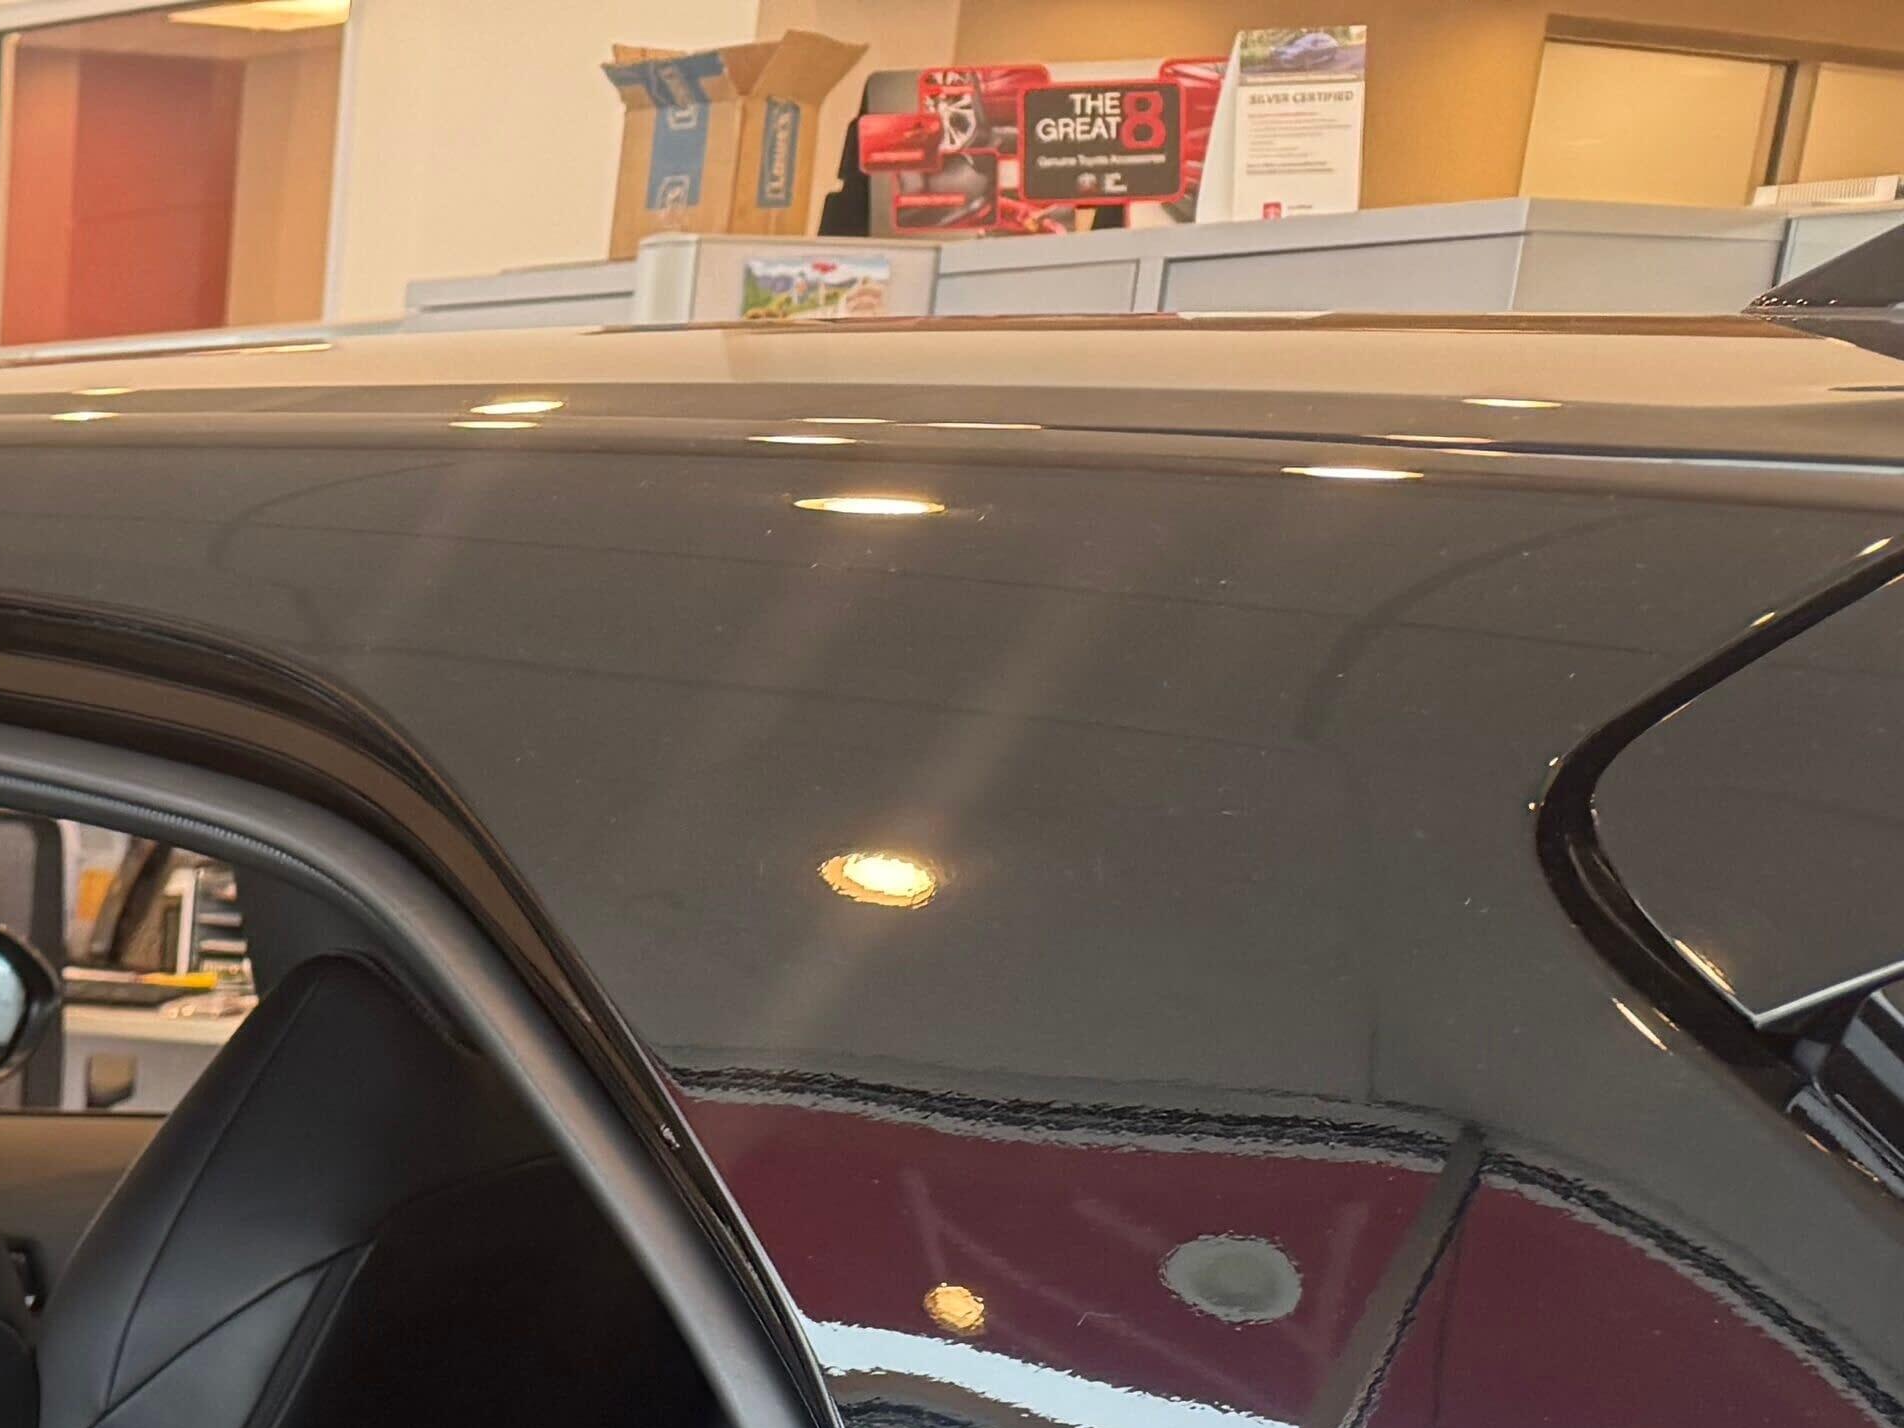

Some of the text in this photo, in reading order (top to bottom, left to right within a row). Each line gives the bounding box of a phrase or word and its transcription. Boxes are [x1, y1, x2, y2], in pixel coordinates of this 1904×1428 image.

[1035, 91, 1166, 149] GREAT 8
[1069, 92, 1121, 115] THE
